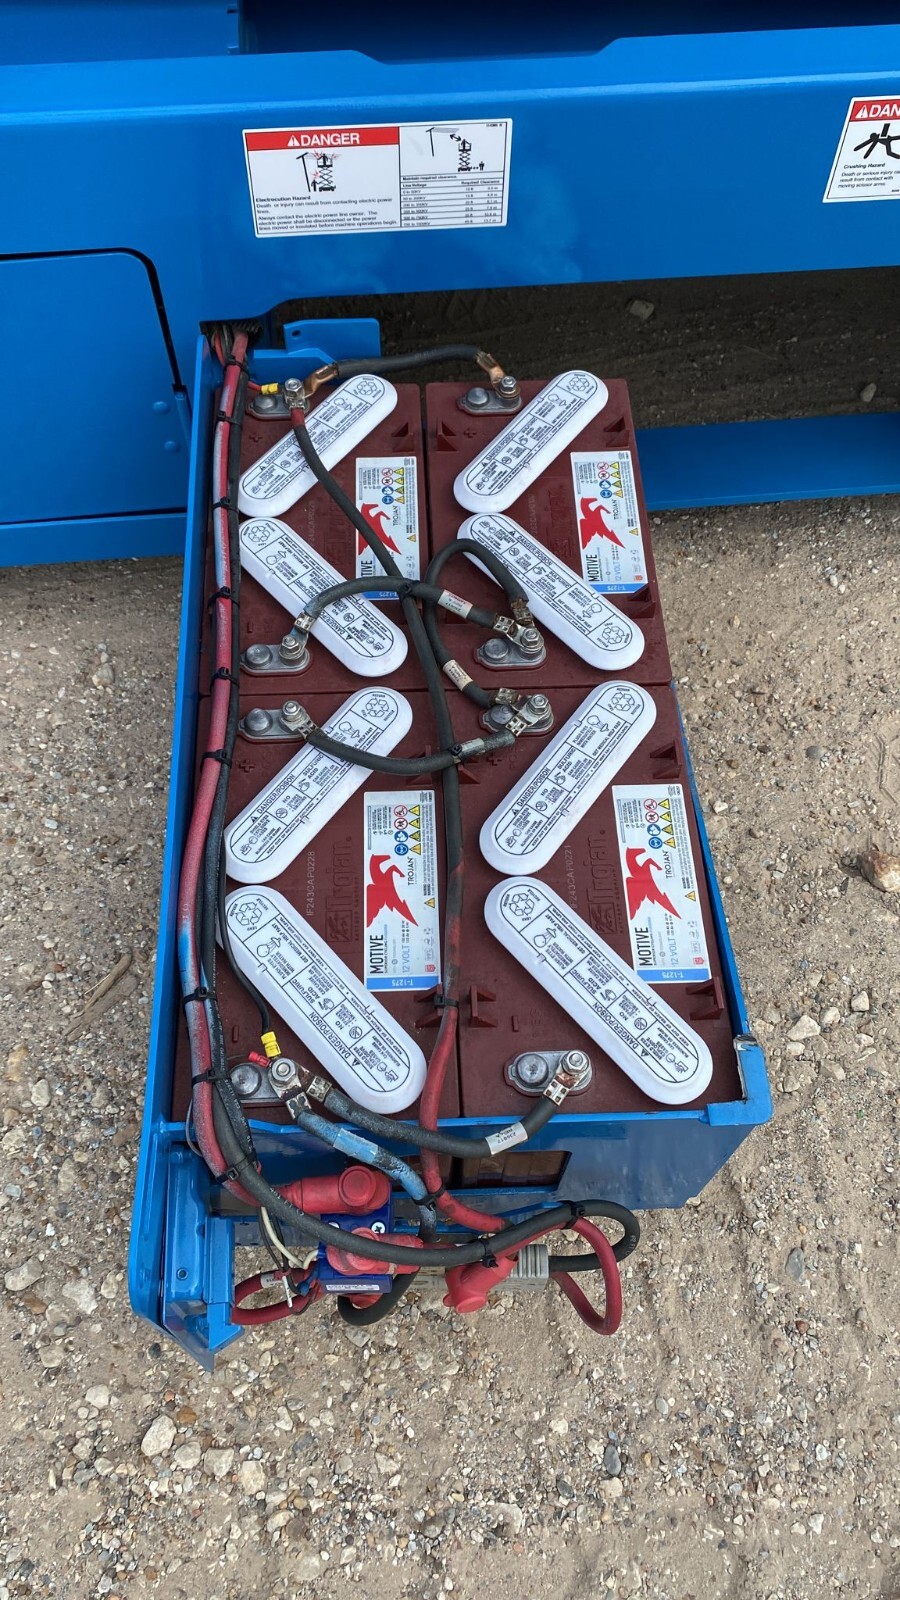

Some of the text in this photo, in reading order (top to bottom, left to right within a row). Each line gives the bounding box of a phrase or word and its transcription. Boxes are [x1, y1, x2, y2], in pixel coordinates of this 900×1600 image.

[300, 132, 360, 147] DANGER
[361, 560, 372, 577] TIVE
[586, 554, 599, 582] MOTIVE
[256, 773, 295, 814] DANGER/POISON
[516, 766, 550, 807] DANGER/POISON
[271, 922, 308, 963] GET MEDICAL HELP FAST
[545, 913, 585, 954] GET MEDICAL HELP FAST
[370, 935, 383, 974] MOTIVE
[402, 945, 410, 964] VOLT
[635, 927, 653, 966] MOTIVE
[668, 937, 677, 957] VOLT
[671, 958, 679, 966] 12
[391, 979, 414, 987] T-1275
[571, 968, 596, 994] SULFURIC
[587, 976, 601, 990] ACID
[661, 970, 685, 978] T-1275
[291, 978, 315, 1004] SULFURIC
[307, 985, 320, 1000] ACID
[335, 1020, 343, 1029] NO
[592, 1001, 638, 1049] DANGER/POISON
[618, 1011, 628, 1021] NO
[308, 1010, 351, 1059] DANGER/POISON
